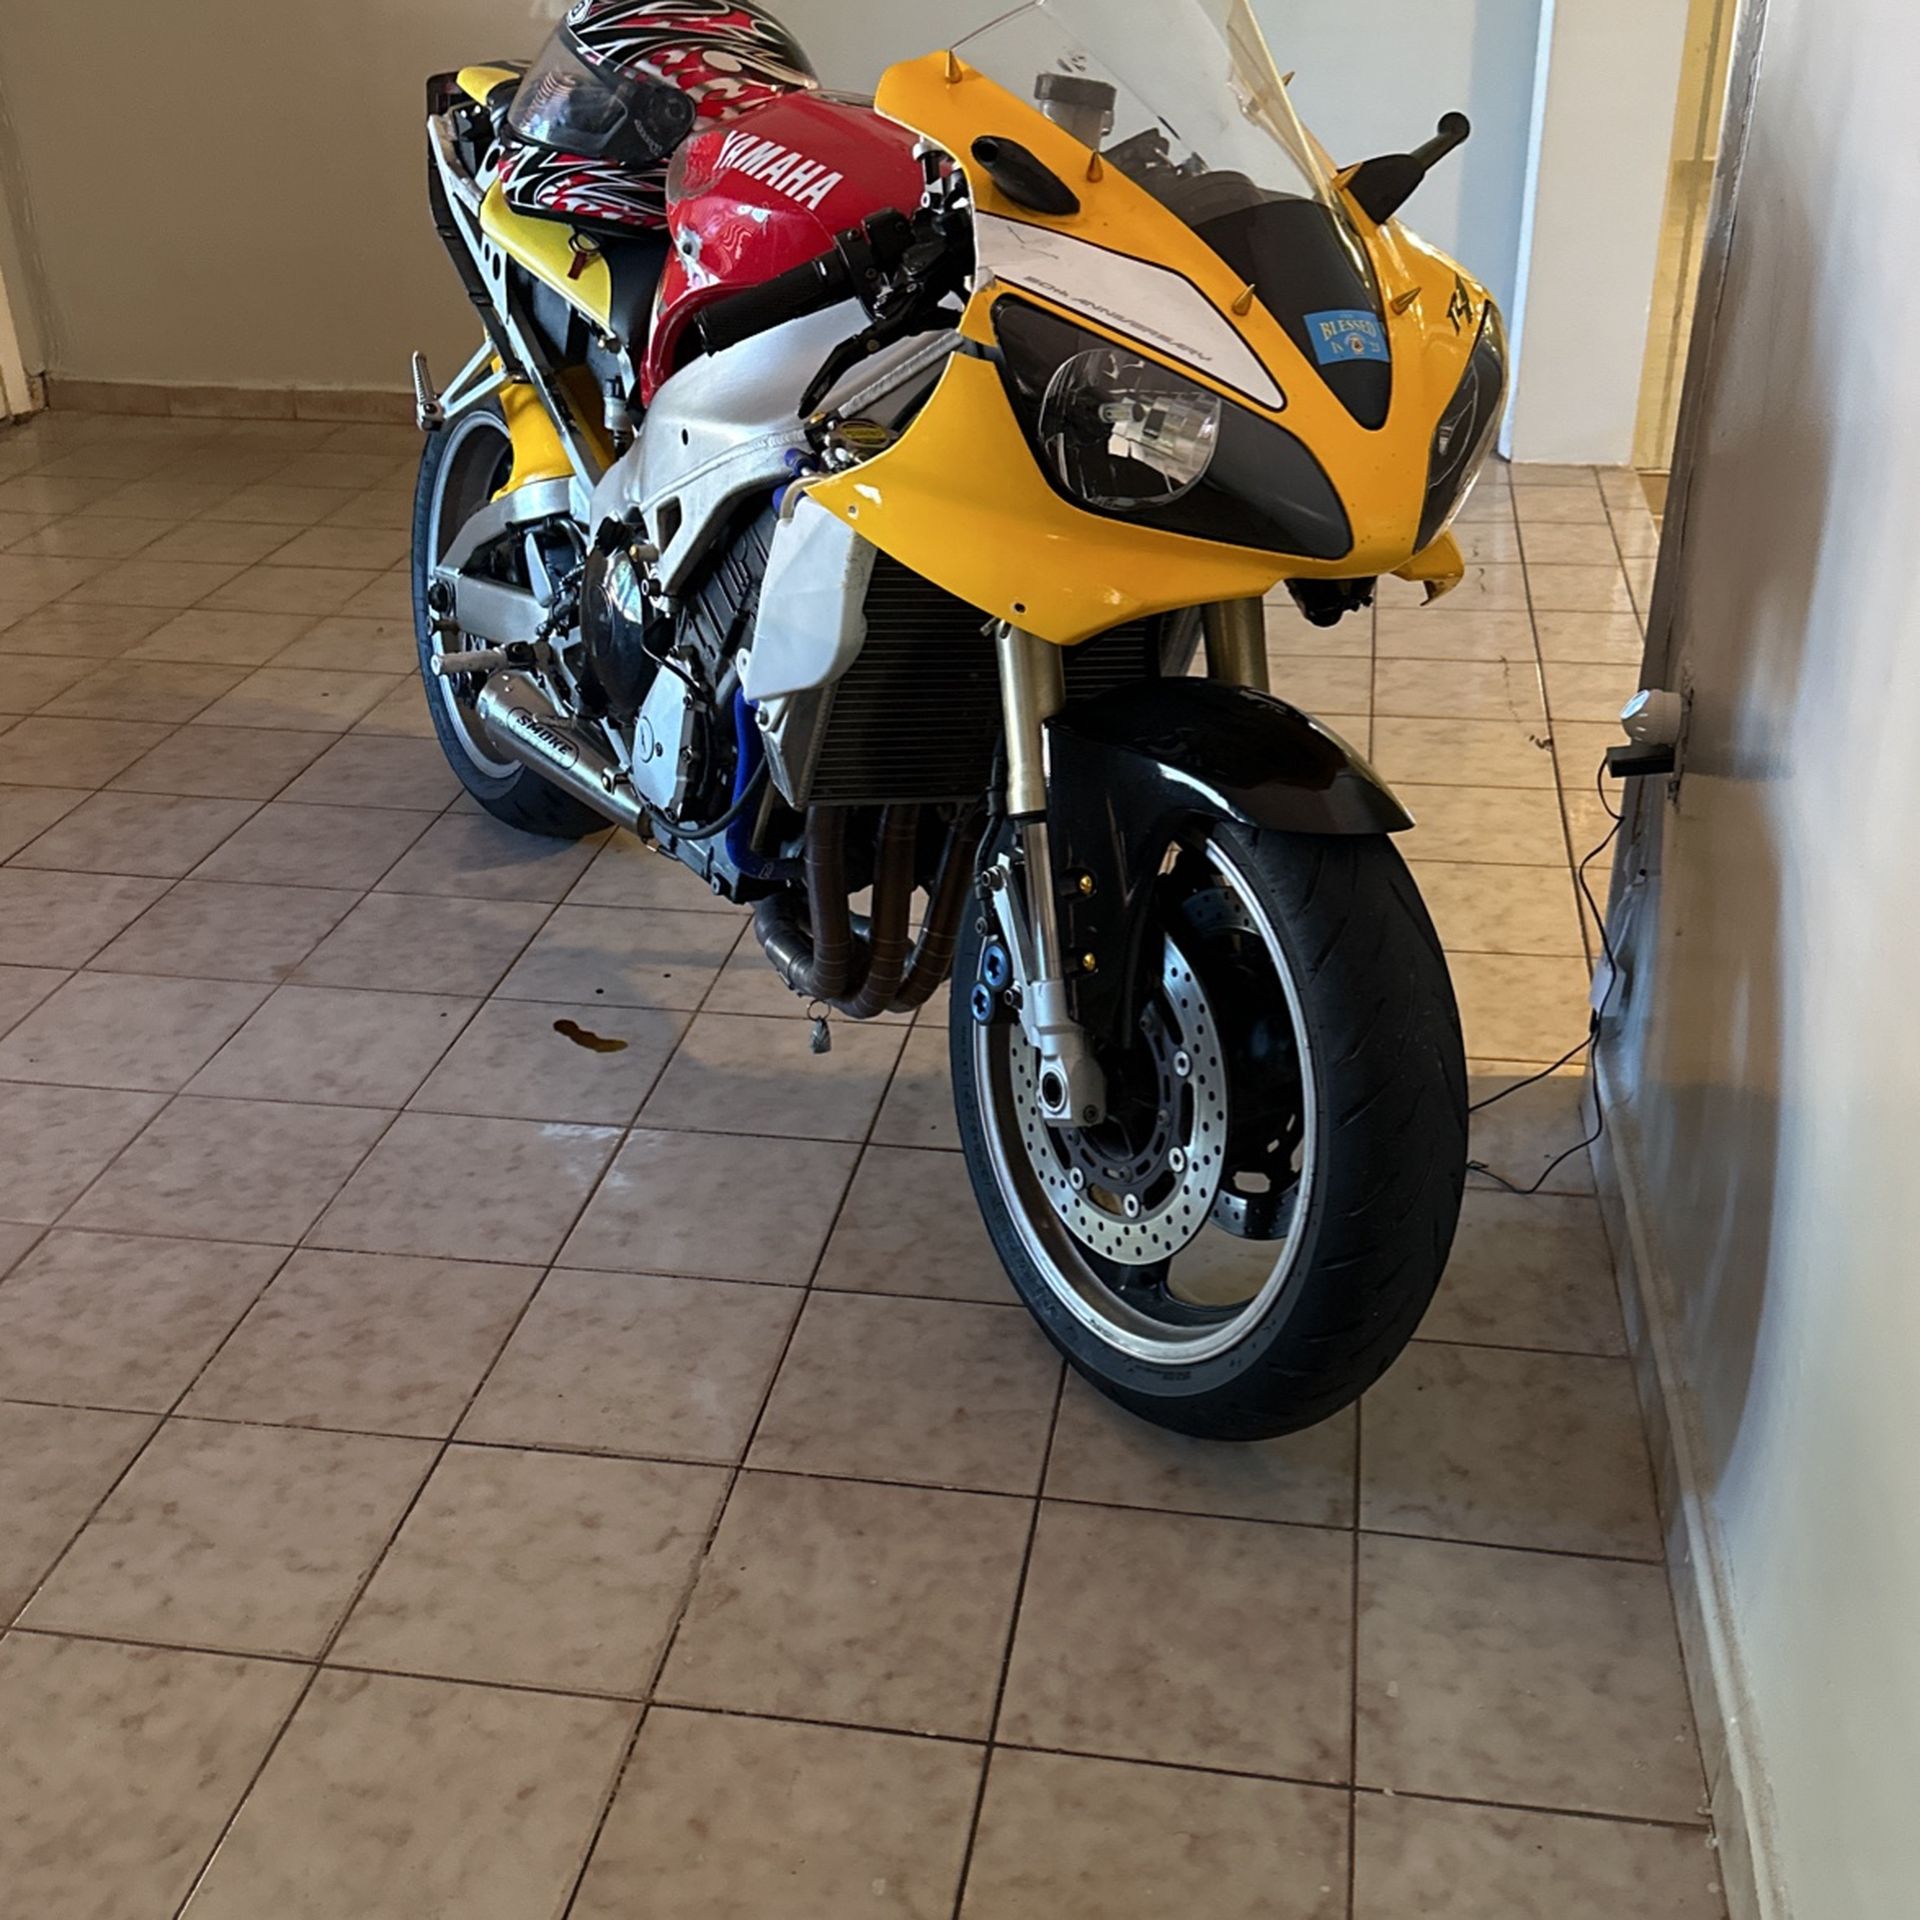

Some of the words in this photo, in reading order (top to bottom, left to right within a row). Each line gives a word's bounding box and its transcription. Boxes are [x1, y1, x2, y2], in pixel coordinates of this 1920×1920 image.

[712, 129, 844, 211] YAMAHA
[1319, 320, 1377, 341] BLESSED
[516, 714, 573, 755] SMOKE
